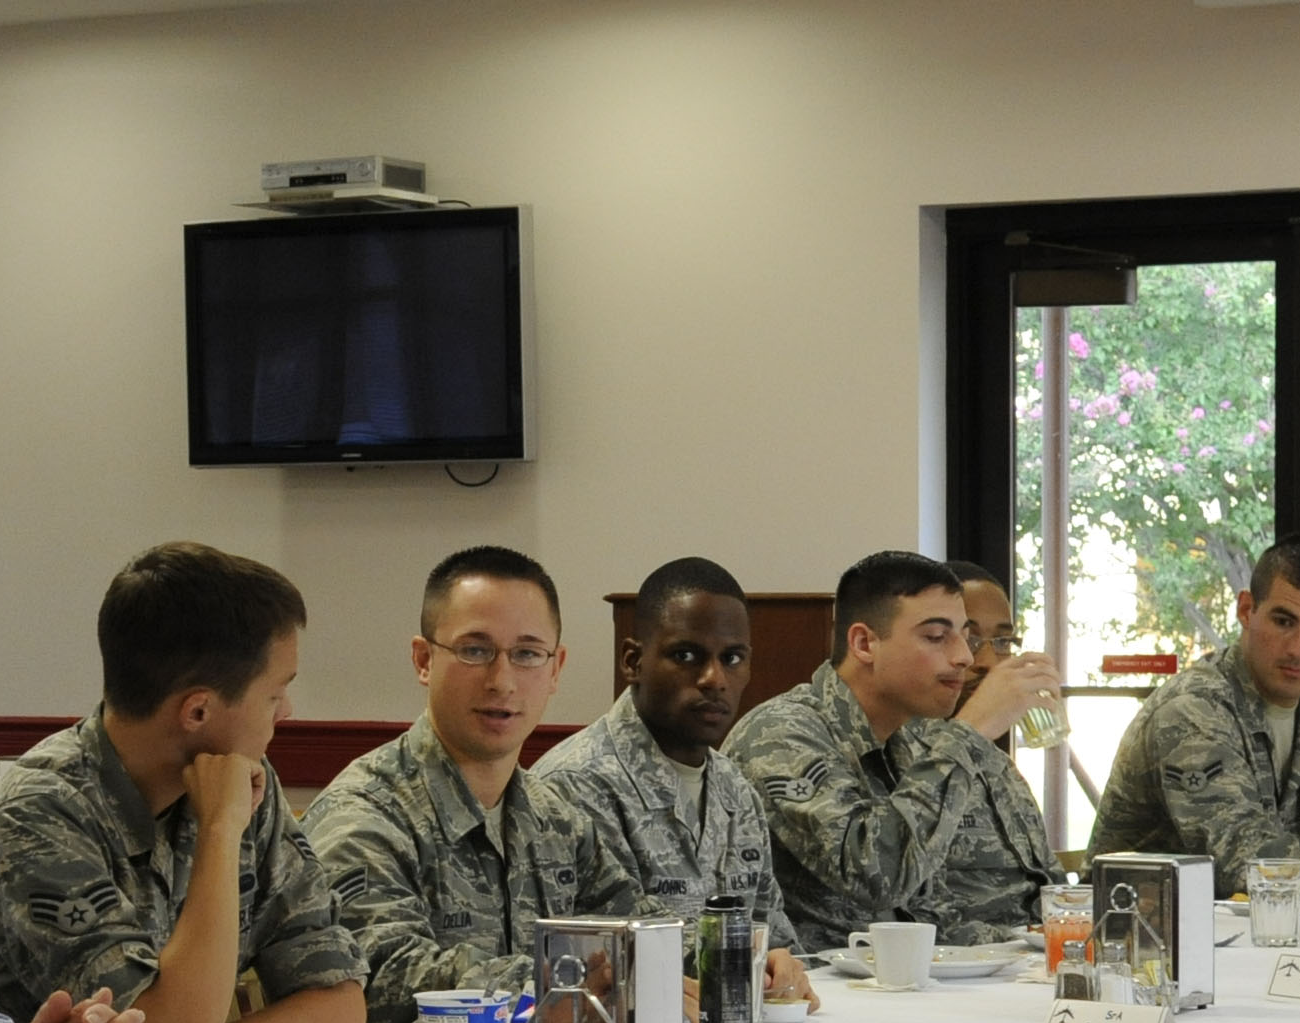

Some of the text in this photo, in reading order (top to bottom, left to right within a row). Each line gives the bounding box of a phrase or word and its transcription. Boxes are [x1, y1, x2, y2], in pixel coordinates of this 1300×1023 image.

[654, 879, 687, 895] JOHNS
[443, 911, 473, 929] DELIA
[1105, 1009, 1124, 1021] SrA
